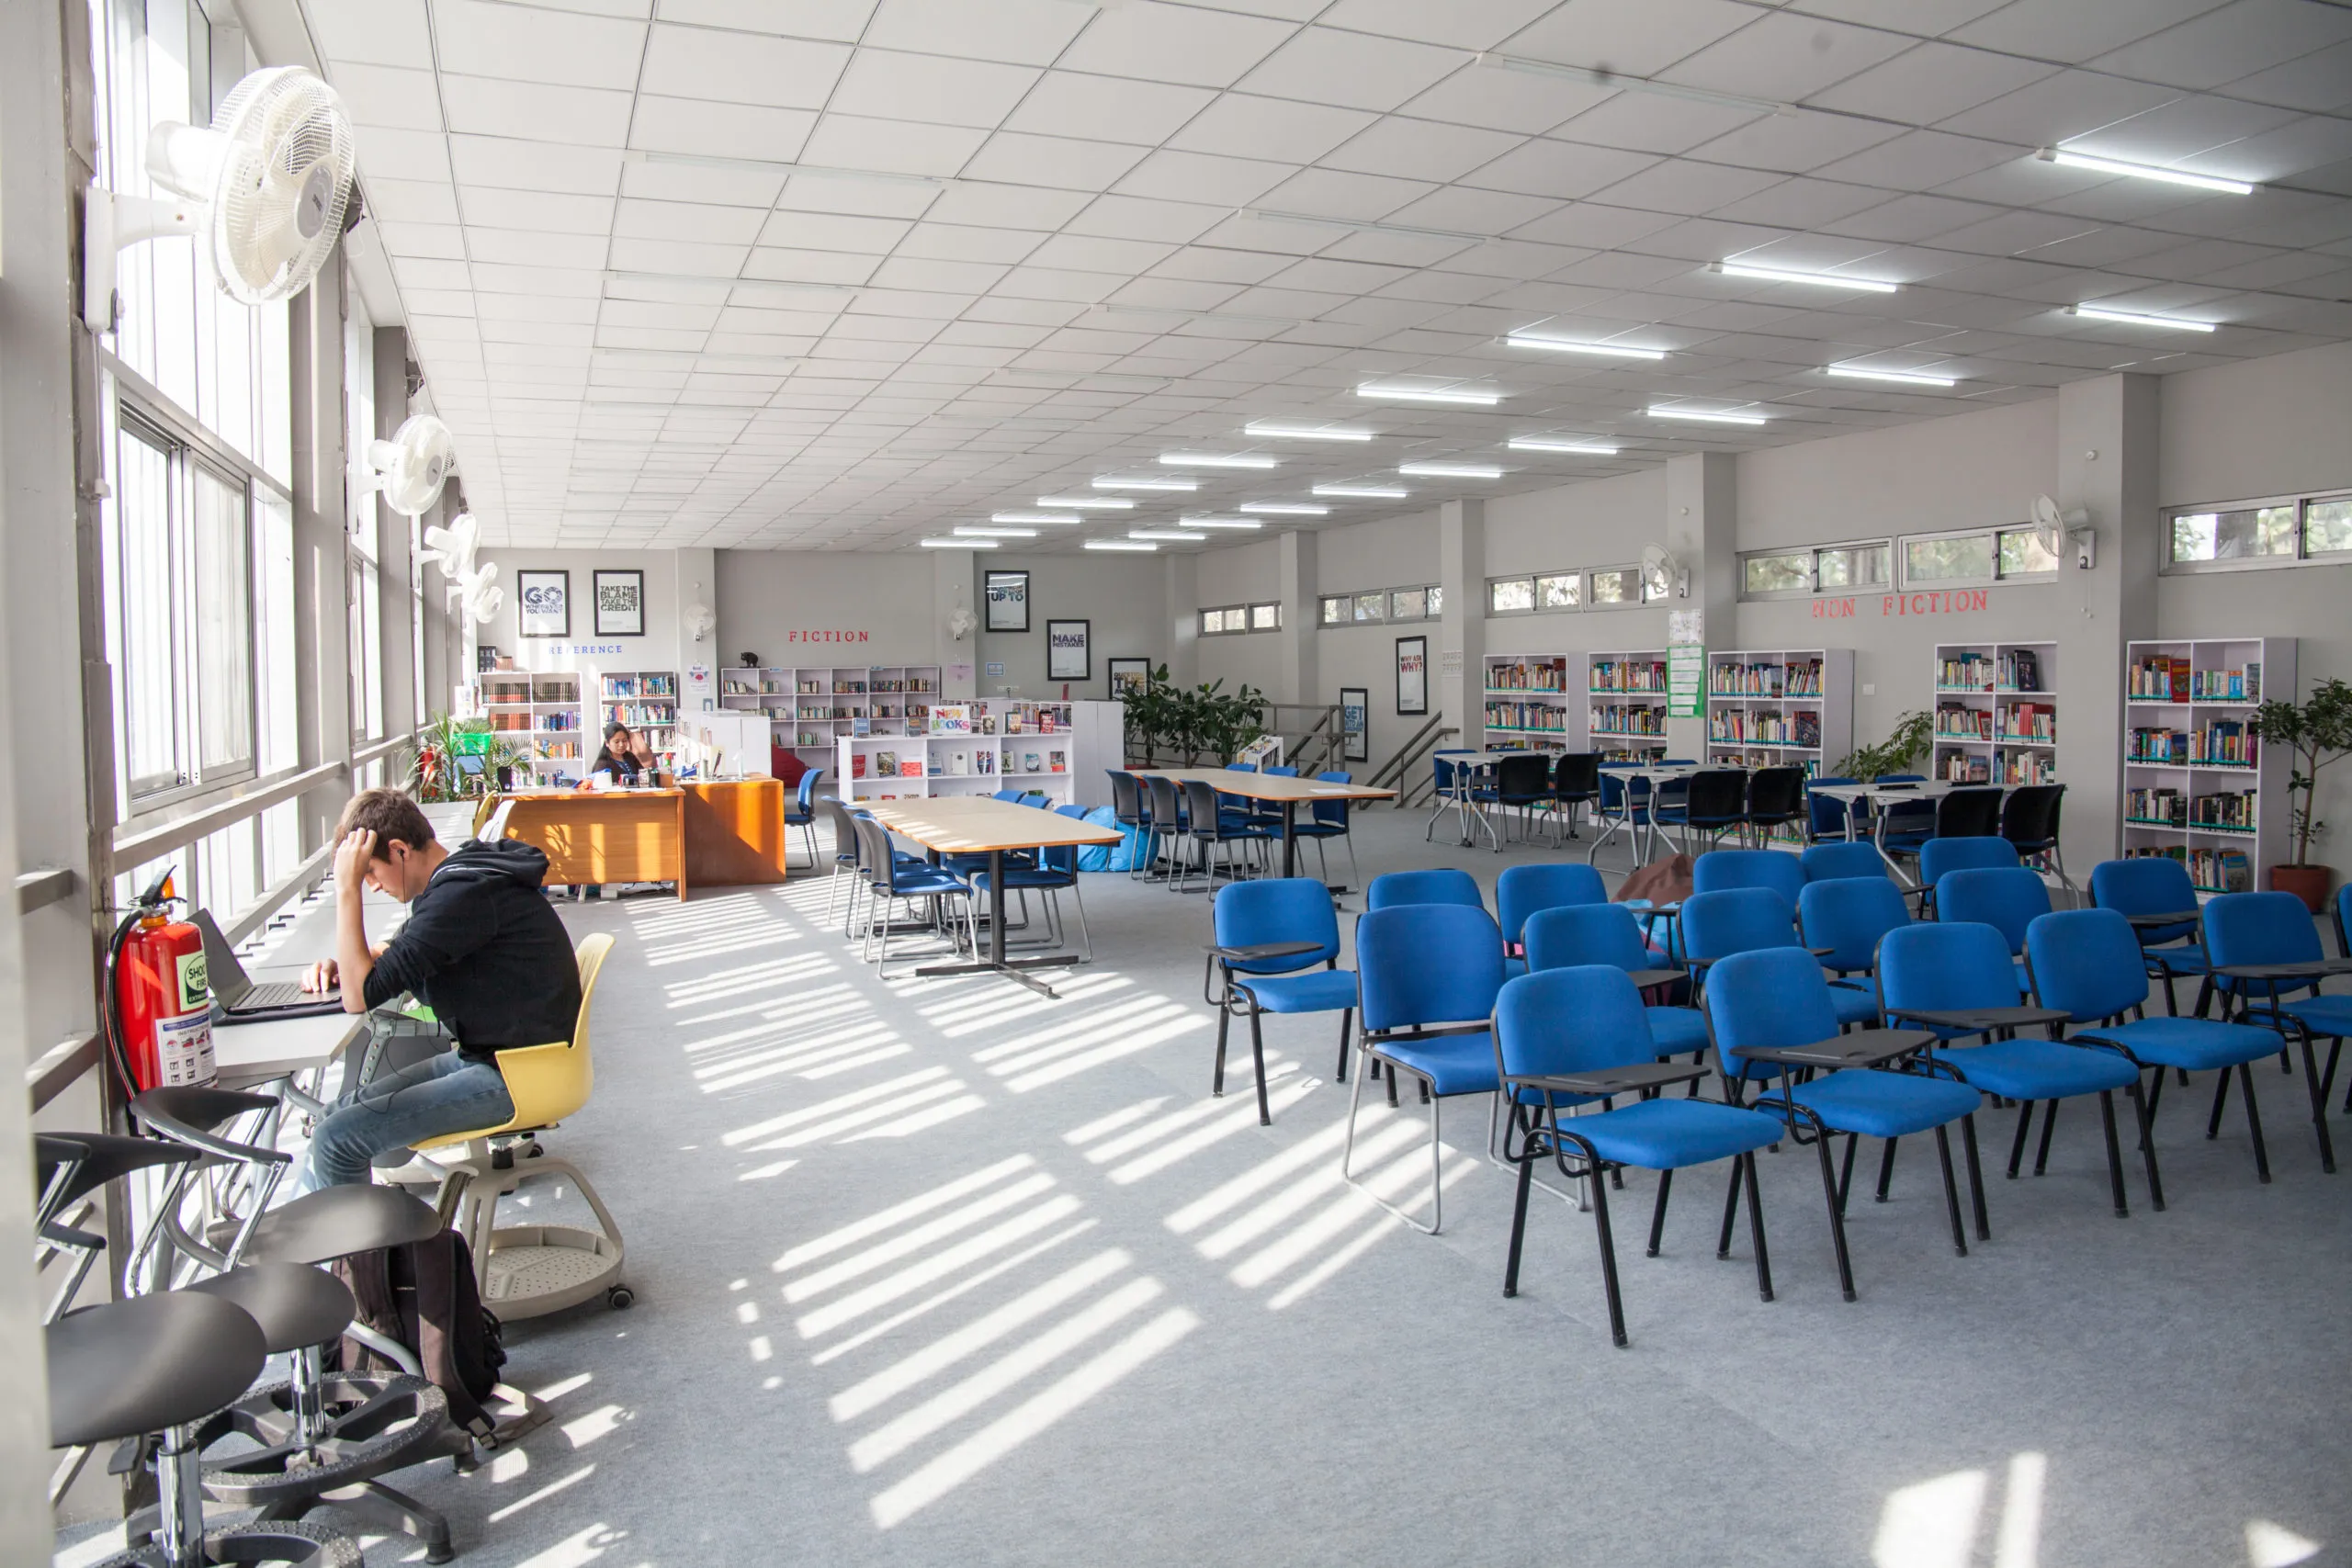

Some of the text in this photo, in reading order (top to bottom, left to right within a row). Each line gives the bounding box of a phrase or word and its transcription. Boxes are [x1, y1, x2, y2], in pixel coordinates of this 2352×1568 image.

[525, 586, 563, 604] GO
[600, 591, 638, 599] BLAME
[991, 592, 1024, 602] UP TO
[600, 604, 638, 612] CREDIT
[1812, 590, 1988, 618] NON FICTION
[788, 631, 869, 642] FICTION
[1052, 634, 1085, 643] MAKE
[549, 645, 623, 655] REERENCE
[1413, 654, 1422, 662] ASK
[1400, 661, 1423, 673] WHY?
[934, 708, 964, 719] NEW
[1344, 705, 1364, 720] GET
[932, 718, 970, 730] BOOKS
